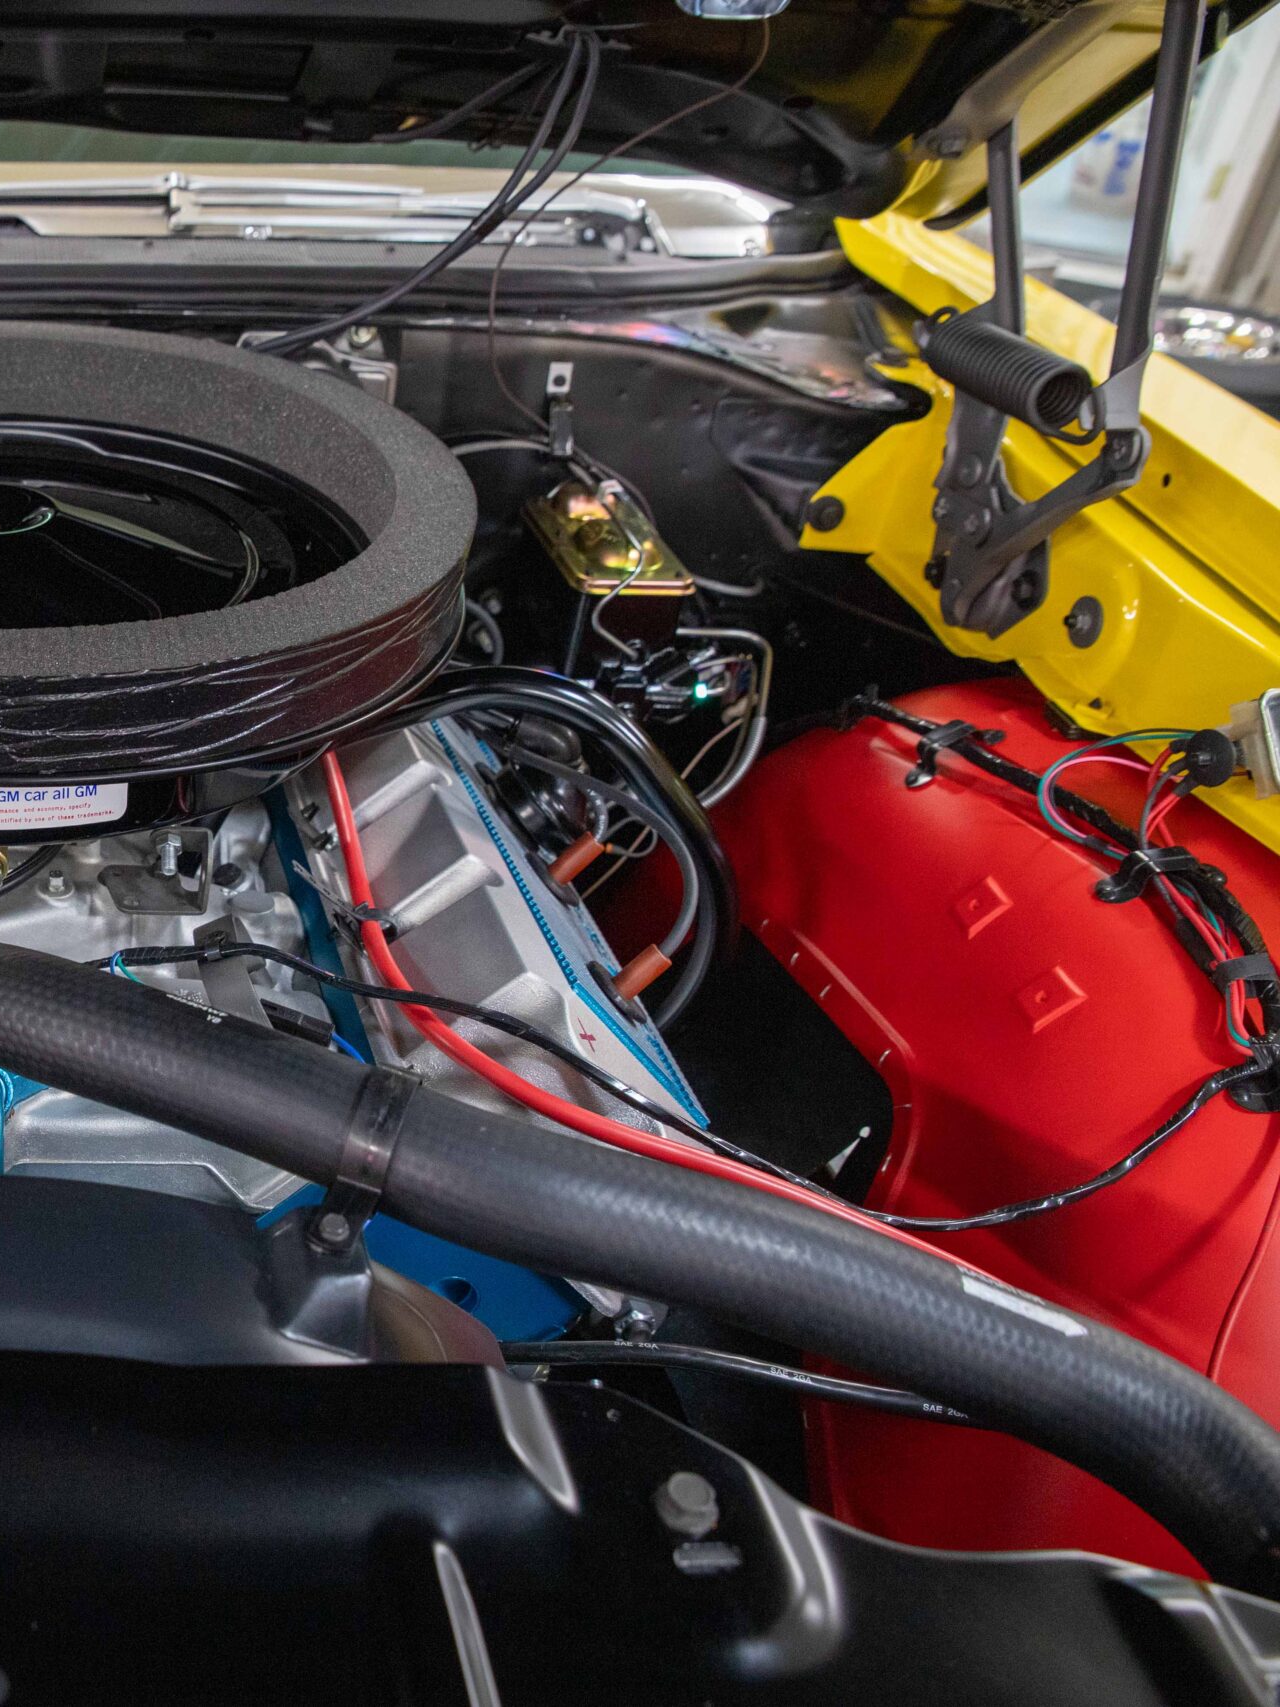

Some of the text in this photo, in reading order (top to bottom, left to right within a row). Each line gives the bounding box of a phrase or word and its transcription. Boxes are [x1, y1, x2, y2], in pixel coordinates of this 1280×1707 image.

[24, 791, 48, 801] car
[52, 787, 70, 800] all
[74, 785, 98, 797] GM
[770, 1366, 789, 1379] SAE
[922, 1403, 943, 1414] SAE
